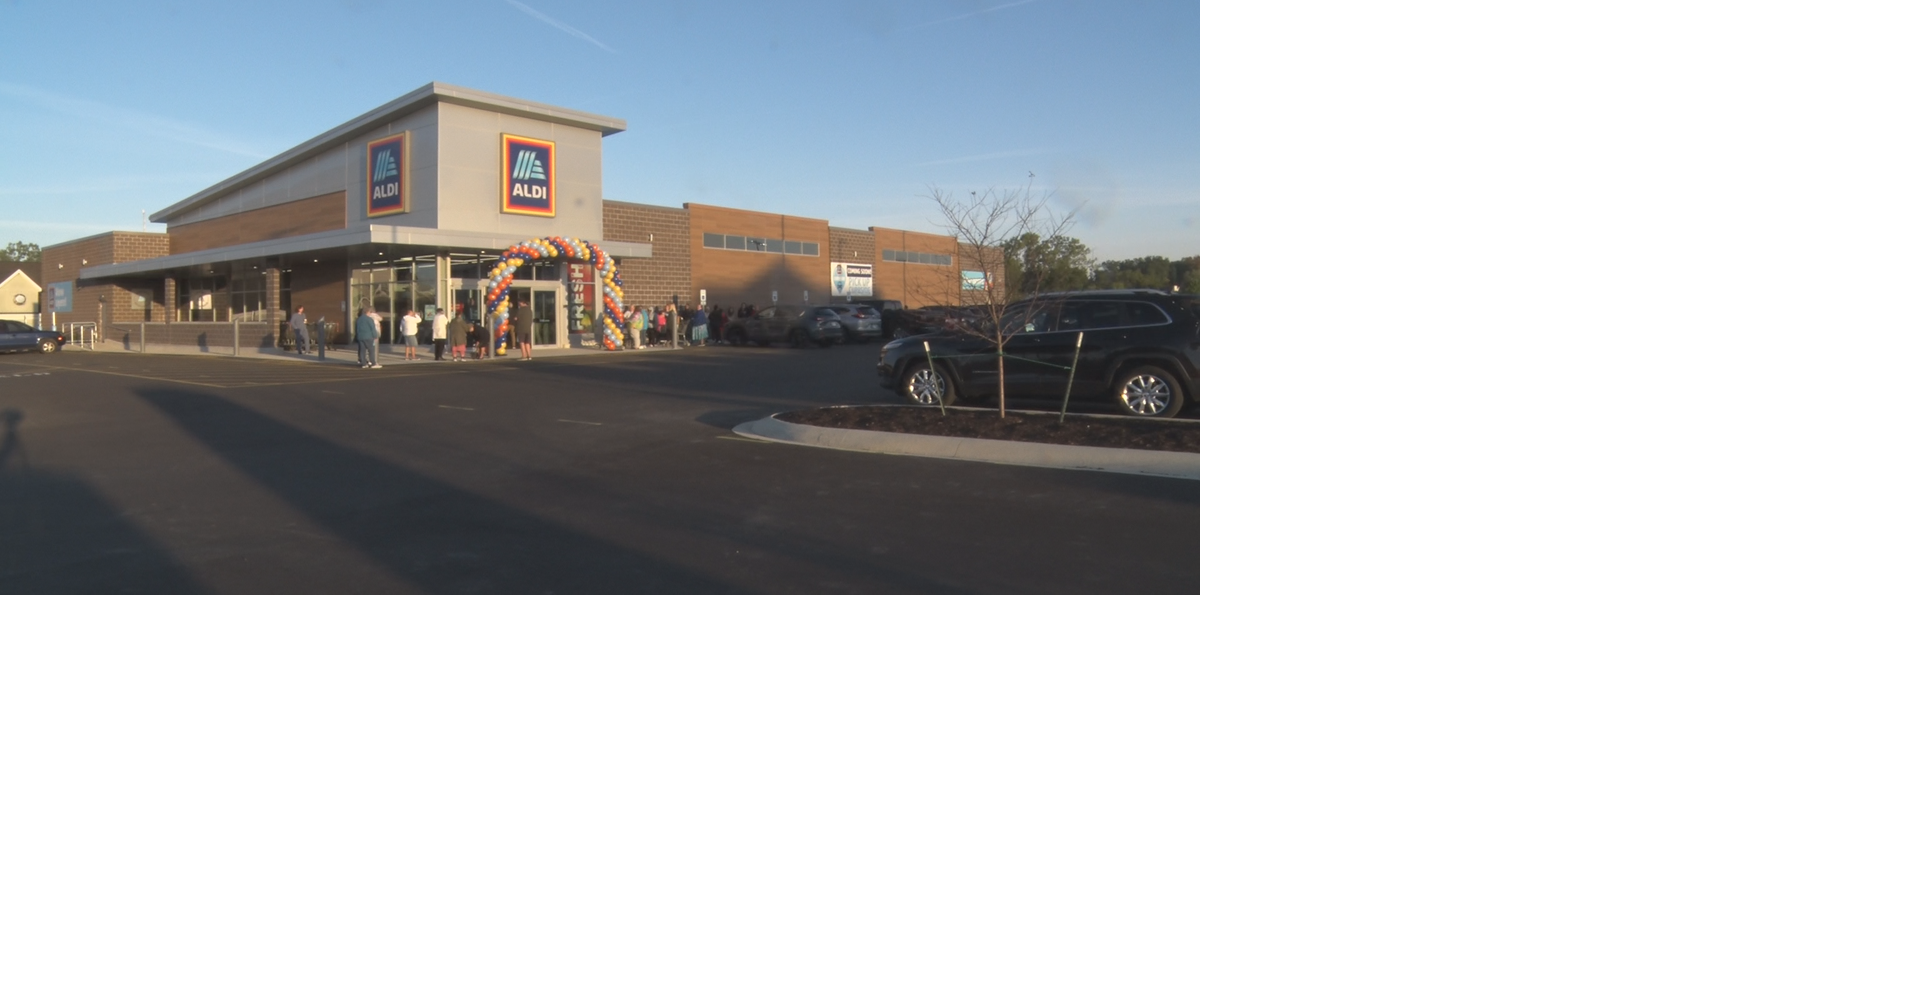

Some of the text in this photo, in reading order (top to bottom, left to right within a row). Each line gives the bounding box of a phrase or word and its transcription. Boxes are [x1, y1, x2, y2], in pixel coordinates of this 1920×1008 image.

[373, 182, 399, 199] ALDI
[512, 183, 547, 199] ALDI
[571, 263, 584, 330] FRESH
